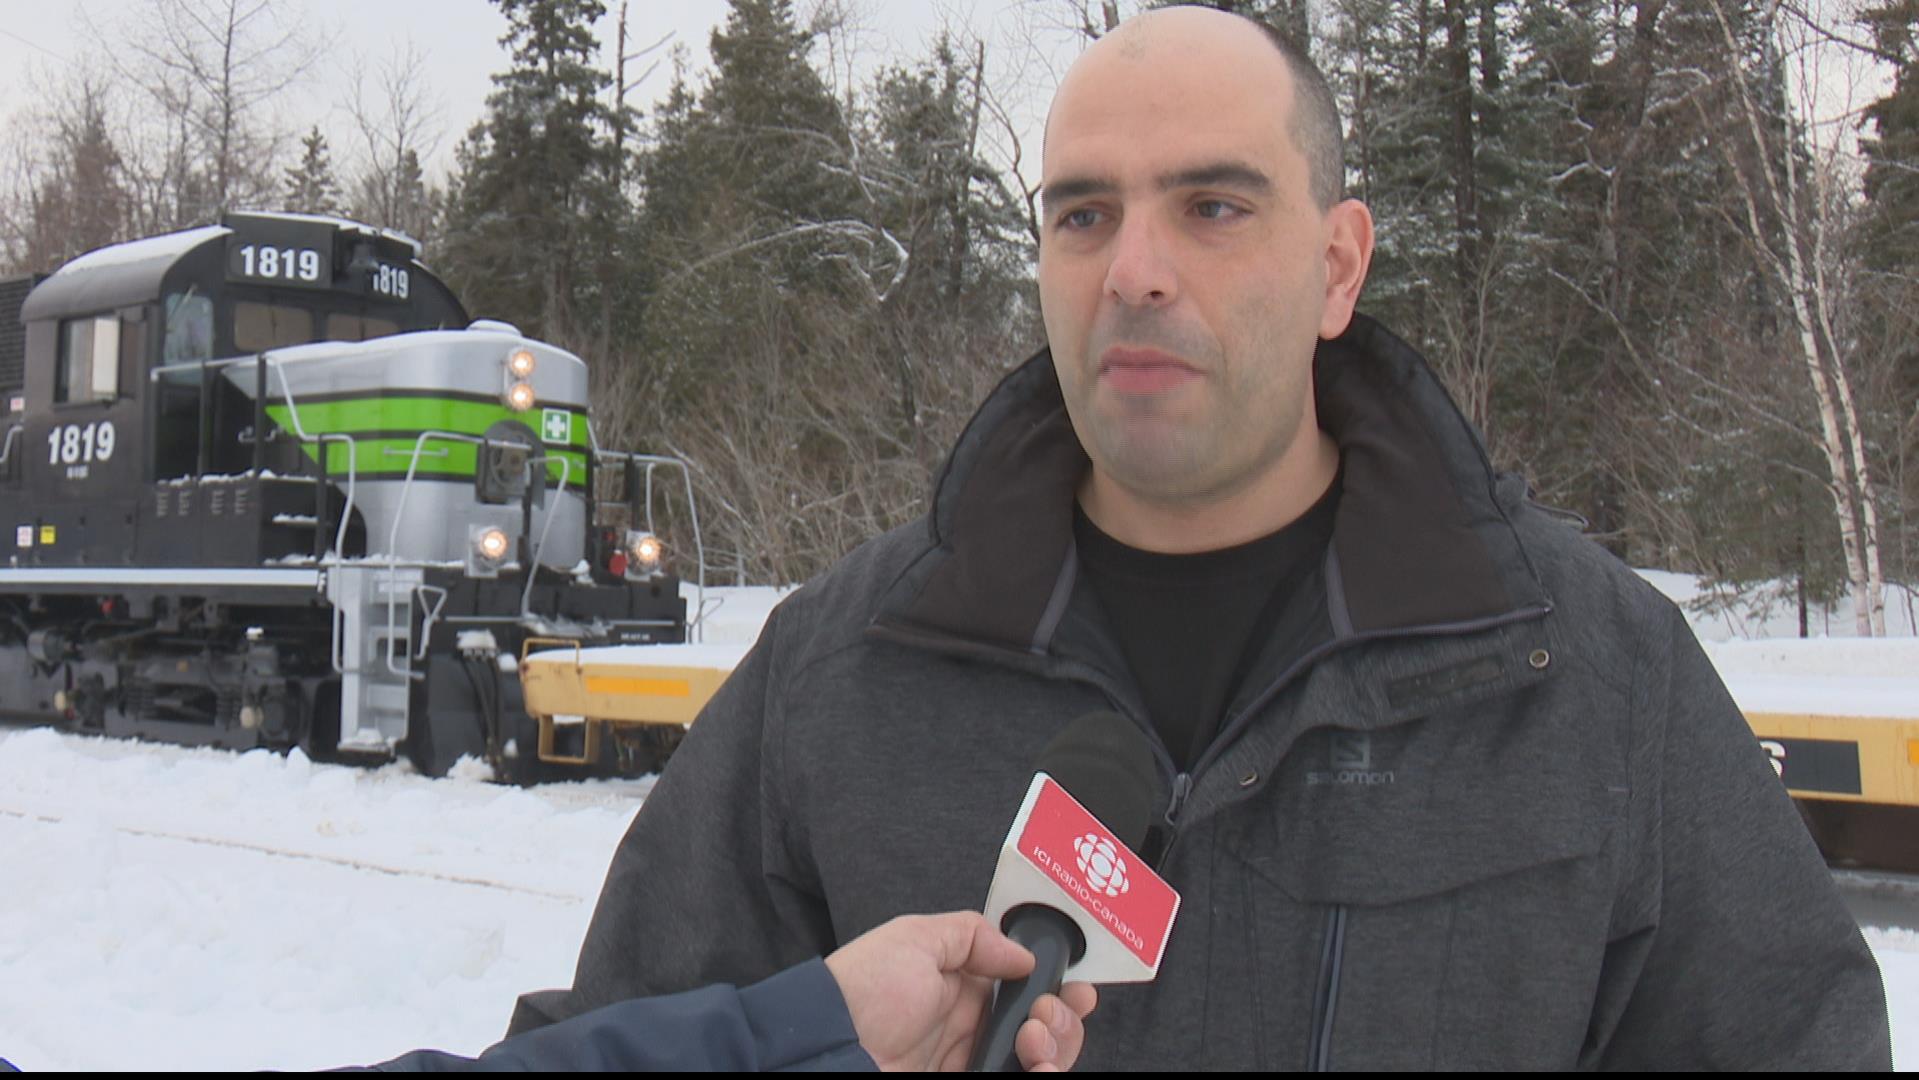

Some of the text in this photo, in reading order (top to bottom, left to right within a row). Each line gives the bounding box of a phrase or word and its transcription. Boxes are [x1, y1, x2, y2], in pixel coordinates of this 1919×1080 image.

[240, 245, 319, 281] 1819
[48, 421, 115, 464] 1819
[1033, 846, 1051, 866] ICI
